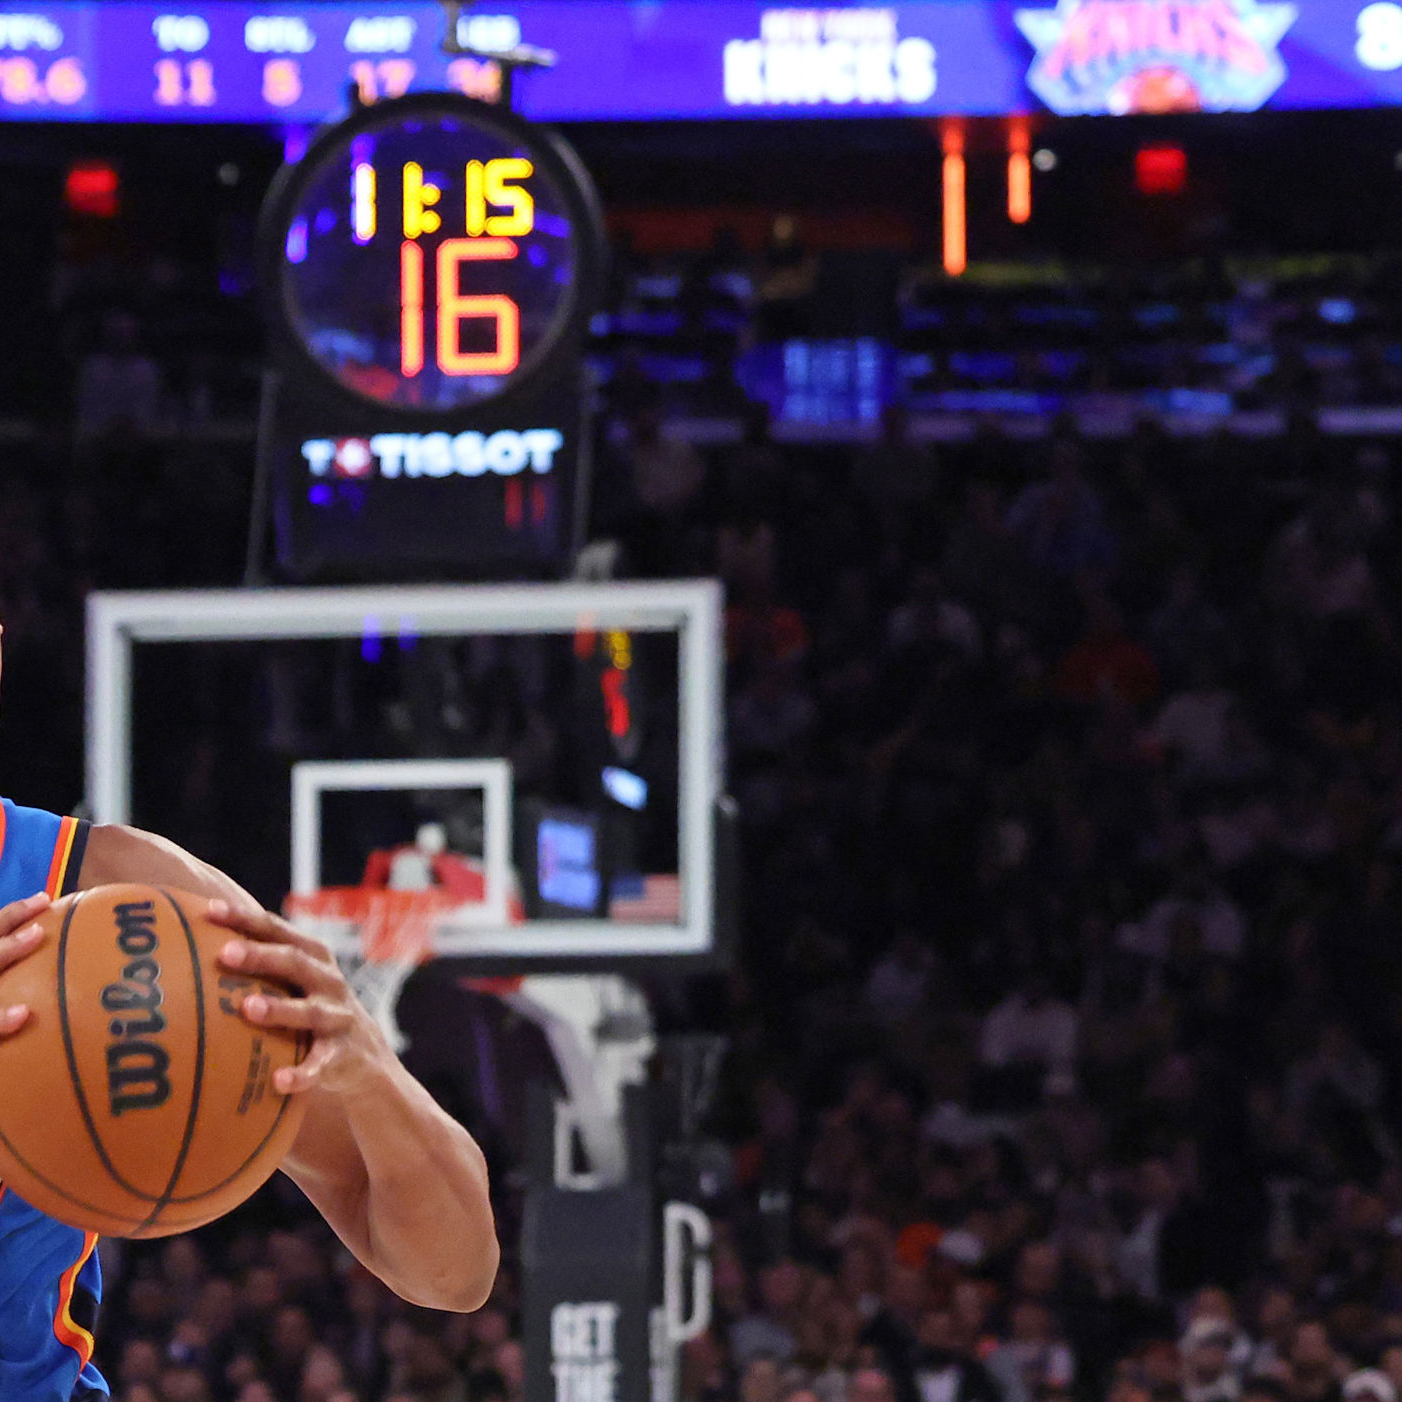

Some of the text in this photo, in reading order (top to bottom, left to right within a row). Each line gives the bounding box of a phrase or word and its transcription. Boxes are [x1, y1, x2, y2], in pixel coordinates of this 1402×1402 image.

[400, 237, 519, 377] 16
[370, 428, 564, 478] TISSOT
[100, 900, 172, 1117] Wilson
[550, 1301, 621, 1358] GET
